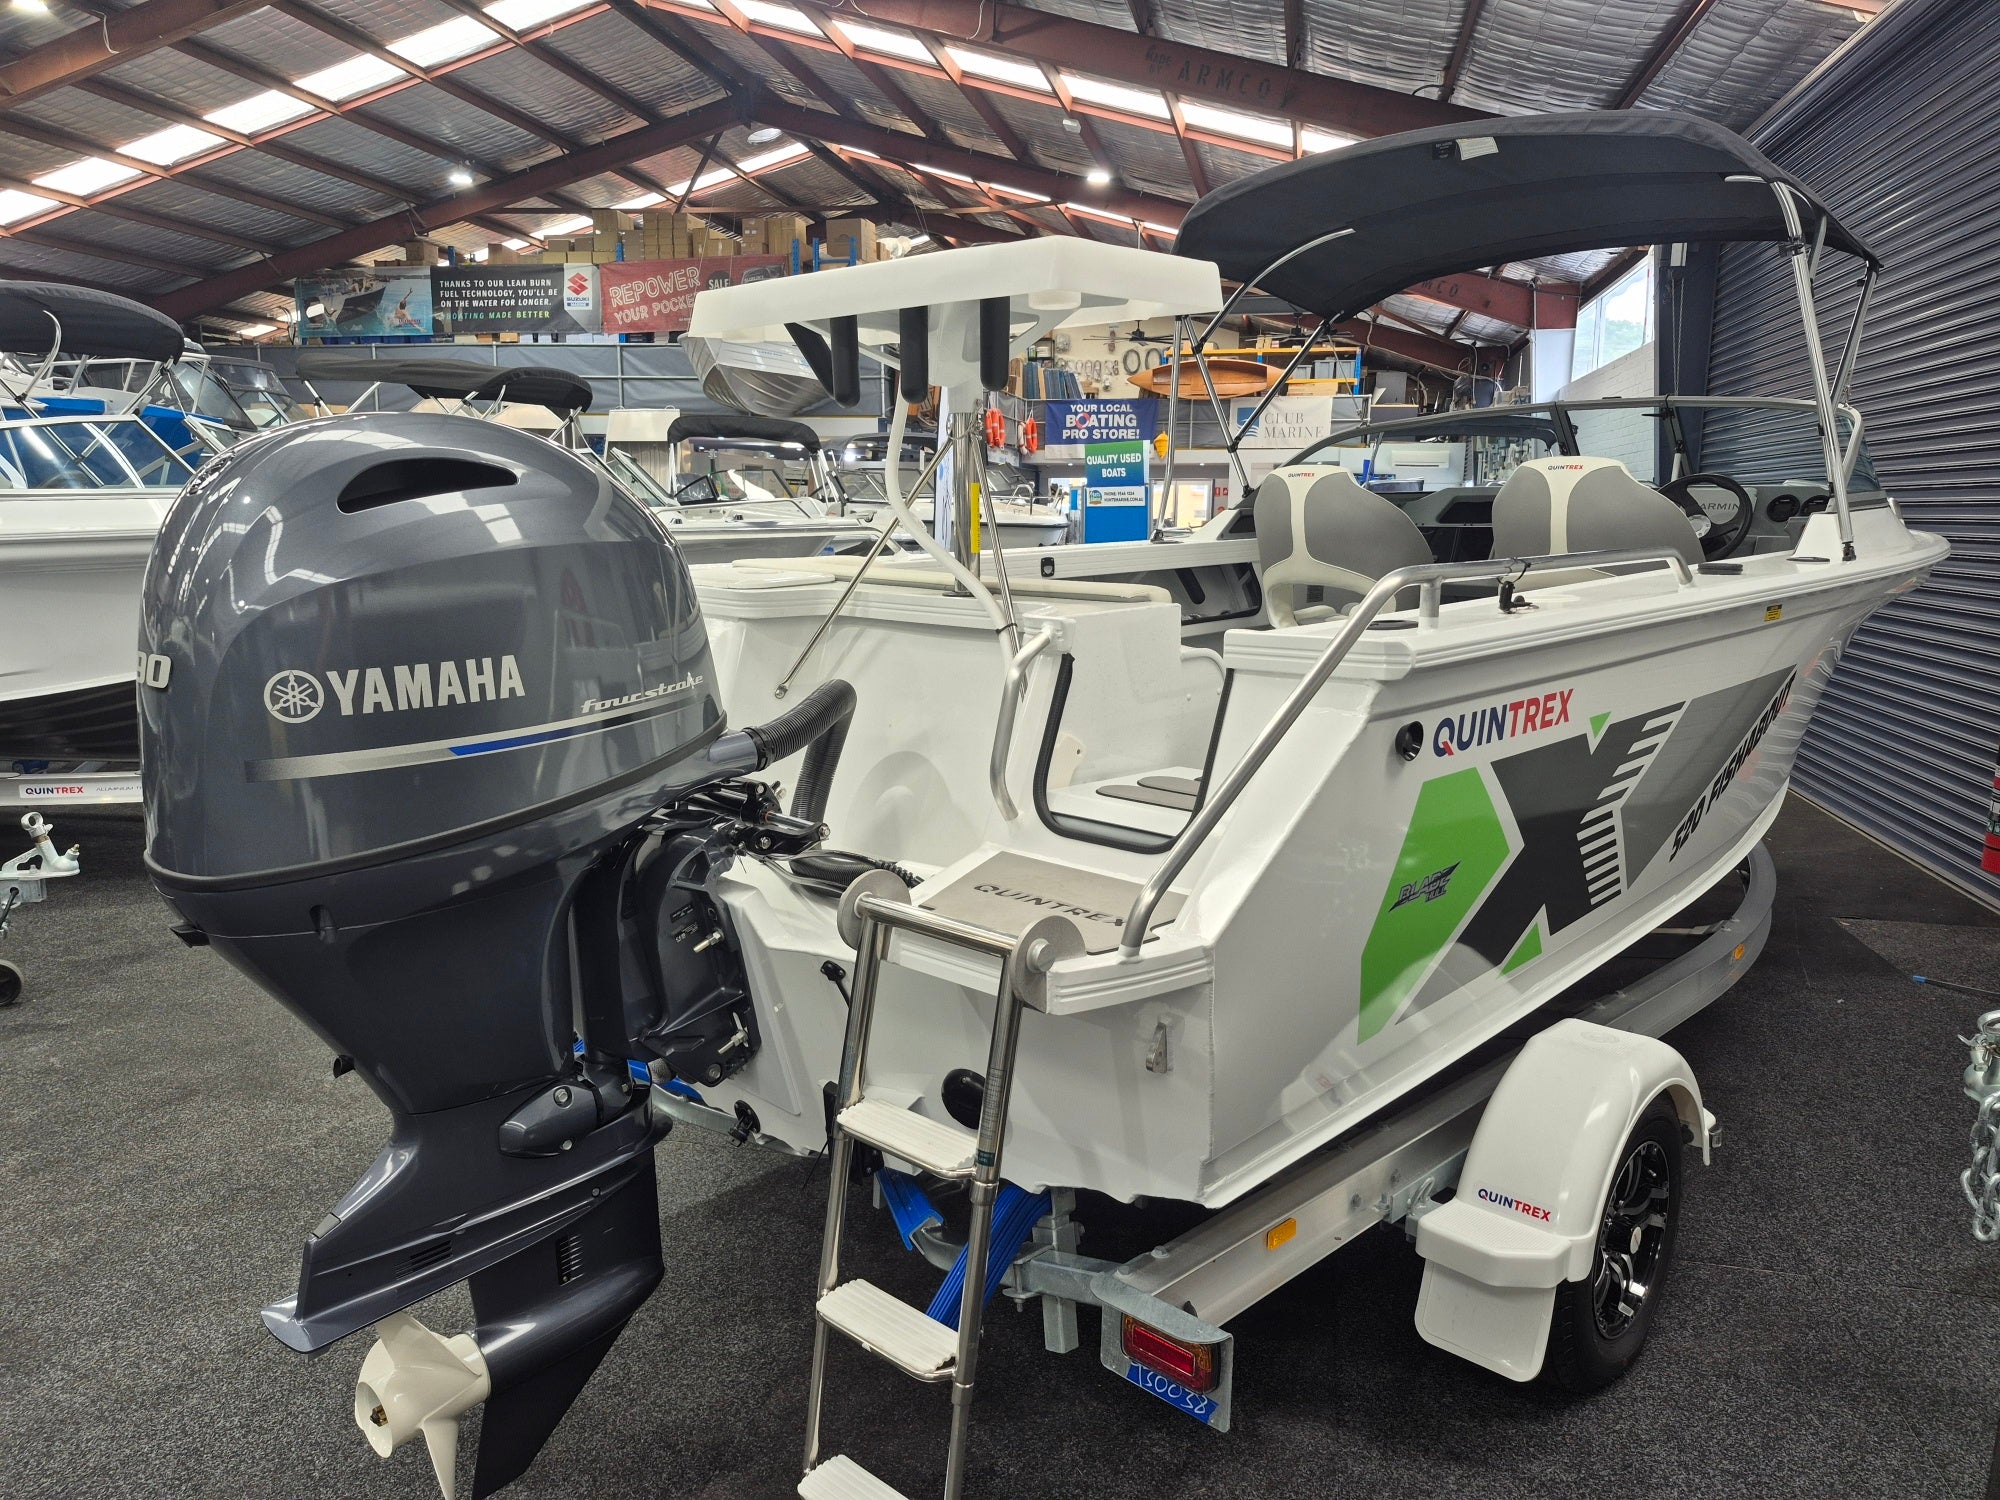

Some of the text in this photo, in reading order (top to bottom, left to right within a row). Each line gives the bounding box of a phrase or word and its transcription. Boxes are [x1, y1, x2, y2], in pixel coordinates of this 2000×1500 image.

[1178, 60, 1272, 100] ARMCO
[440, 280, 471, 288] THANKS
[507, 279, 527, 287] LEAN
[530, 279, 551, 287] BURN
[609, 266, 700, 307] REPOWER
[708, 278, 730, 290] SALE
[440, 288, 558, 298] FUEL TECHNOLOGY, YOU'LL BE
[440, 300, 452, 308] ON
[455, 300, 470, 308] THE
[472, 299, 498, 307] WATER
[518, 298, 552, 306] LONGER.
[614, 290, 698, 325] YOUR POCKE
[488, 311, 512, 319] MADE
[516, 310, 550, 319] BETTER
[1070, 404, 1133, 412] YOUR LOCAL
[1065, 412, 1137, 429] BOATING
[1264, 412, 1304, 425] CLUB
[1062, 429, 1140, 439] PRO STORE!
[1264, 426, 1324, 439] MARINE
[1086, 453, 1142, 465] QUALITY USED
[1101, 468, 1126, 478] BOATS
[326, 655, 526, 716] YAMAHA
[1432, 688, 1574, 758] QUINTREX
[1669, 670, 1797, 862] 520 FISHABOUT
[25, 786, 84, 795] QUINTREX
[1395, 866, 1454, 904] BLADE
[974, 884, 1127, 926] QUINTREX
[1478, 1188, 1551, 1222] QUINTREX
